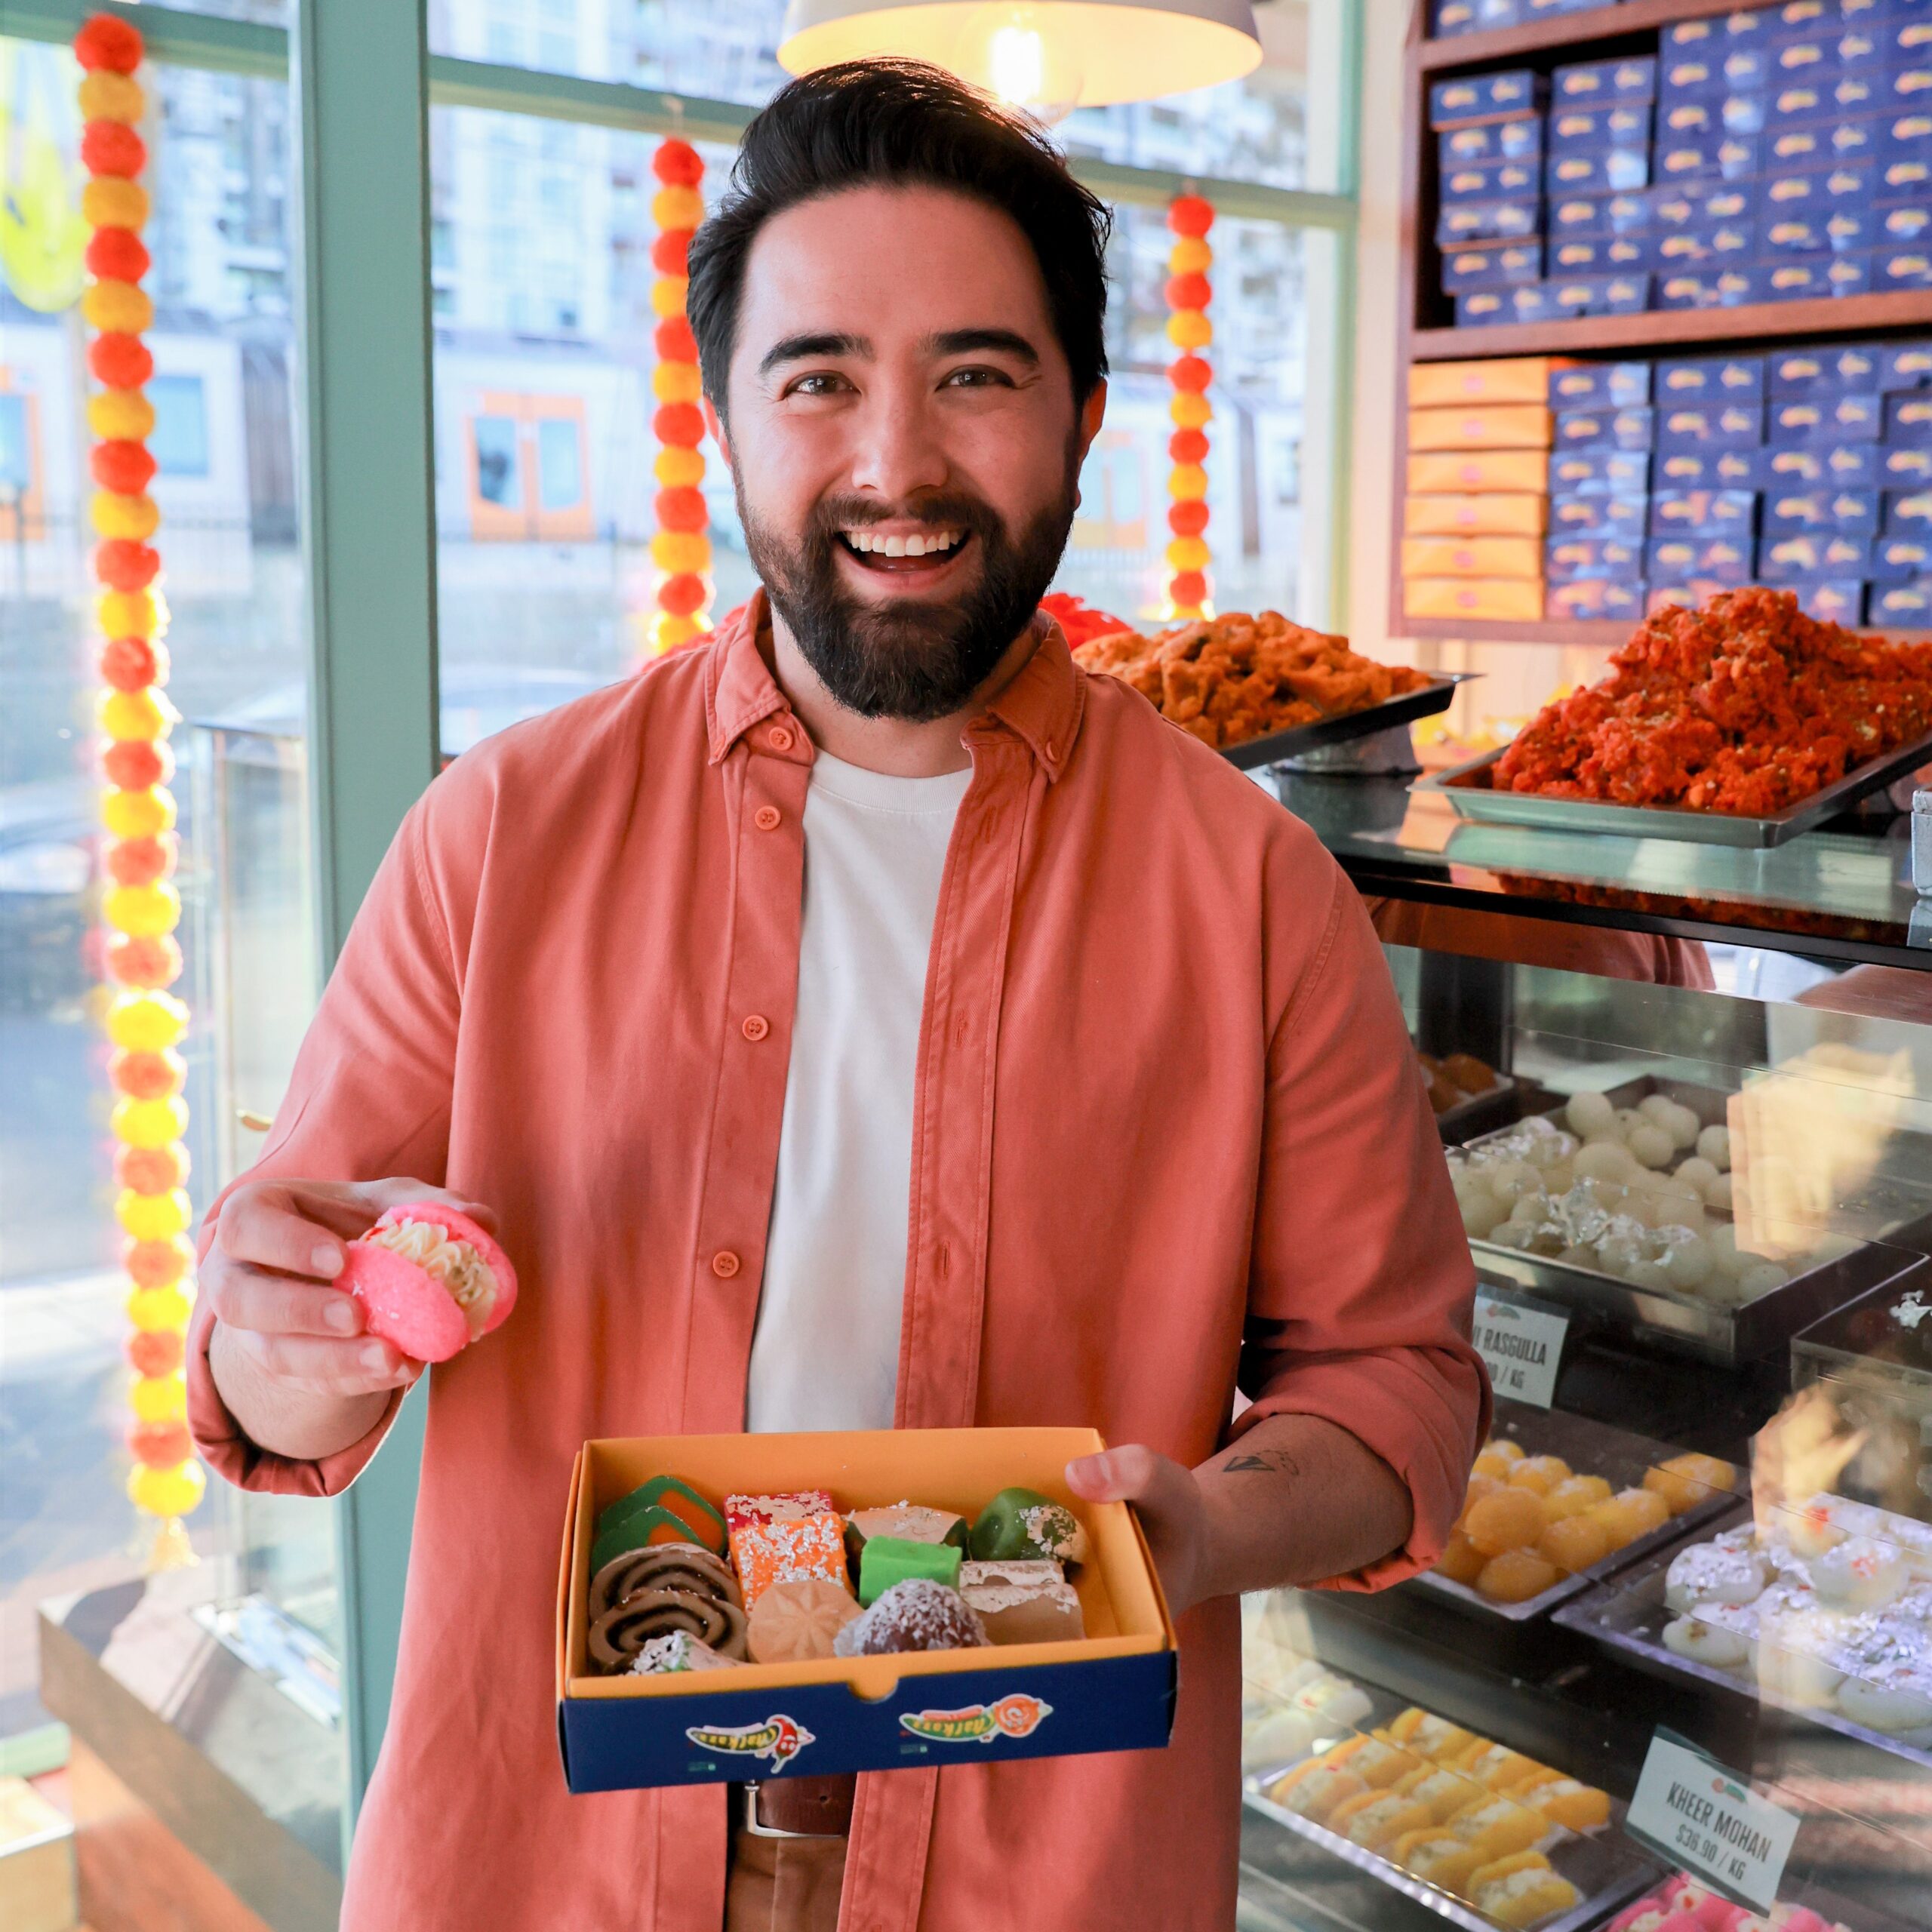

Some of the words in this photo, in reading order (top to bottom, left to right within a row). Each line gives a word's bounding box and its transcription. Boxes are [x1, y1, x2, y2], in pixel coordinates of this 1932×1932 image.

[1483, 1328, 1546, 1366] RASGULLA
[1500, 1366, 1508, 1384] /
[1509, 1369, 1524, 1389] KG
[1666, 1781, 1714, 1826] KHEER
[1713, 1810, 1771, 1863] MOHAN
[1675, 1823, 1718, 1863] $36.90
[1718, 1851, 1729, 1868] /
[1728, 1857, 1746, 1880] KG
